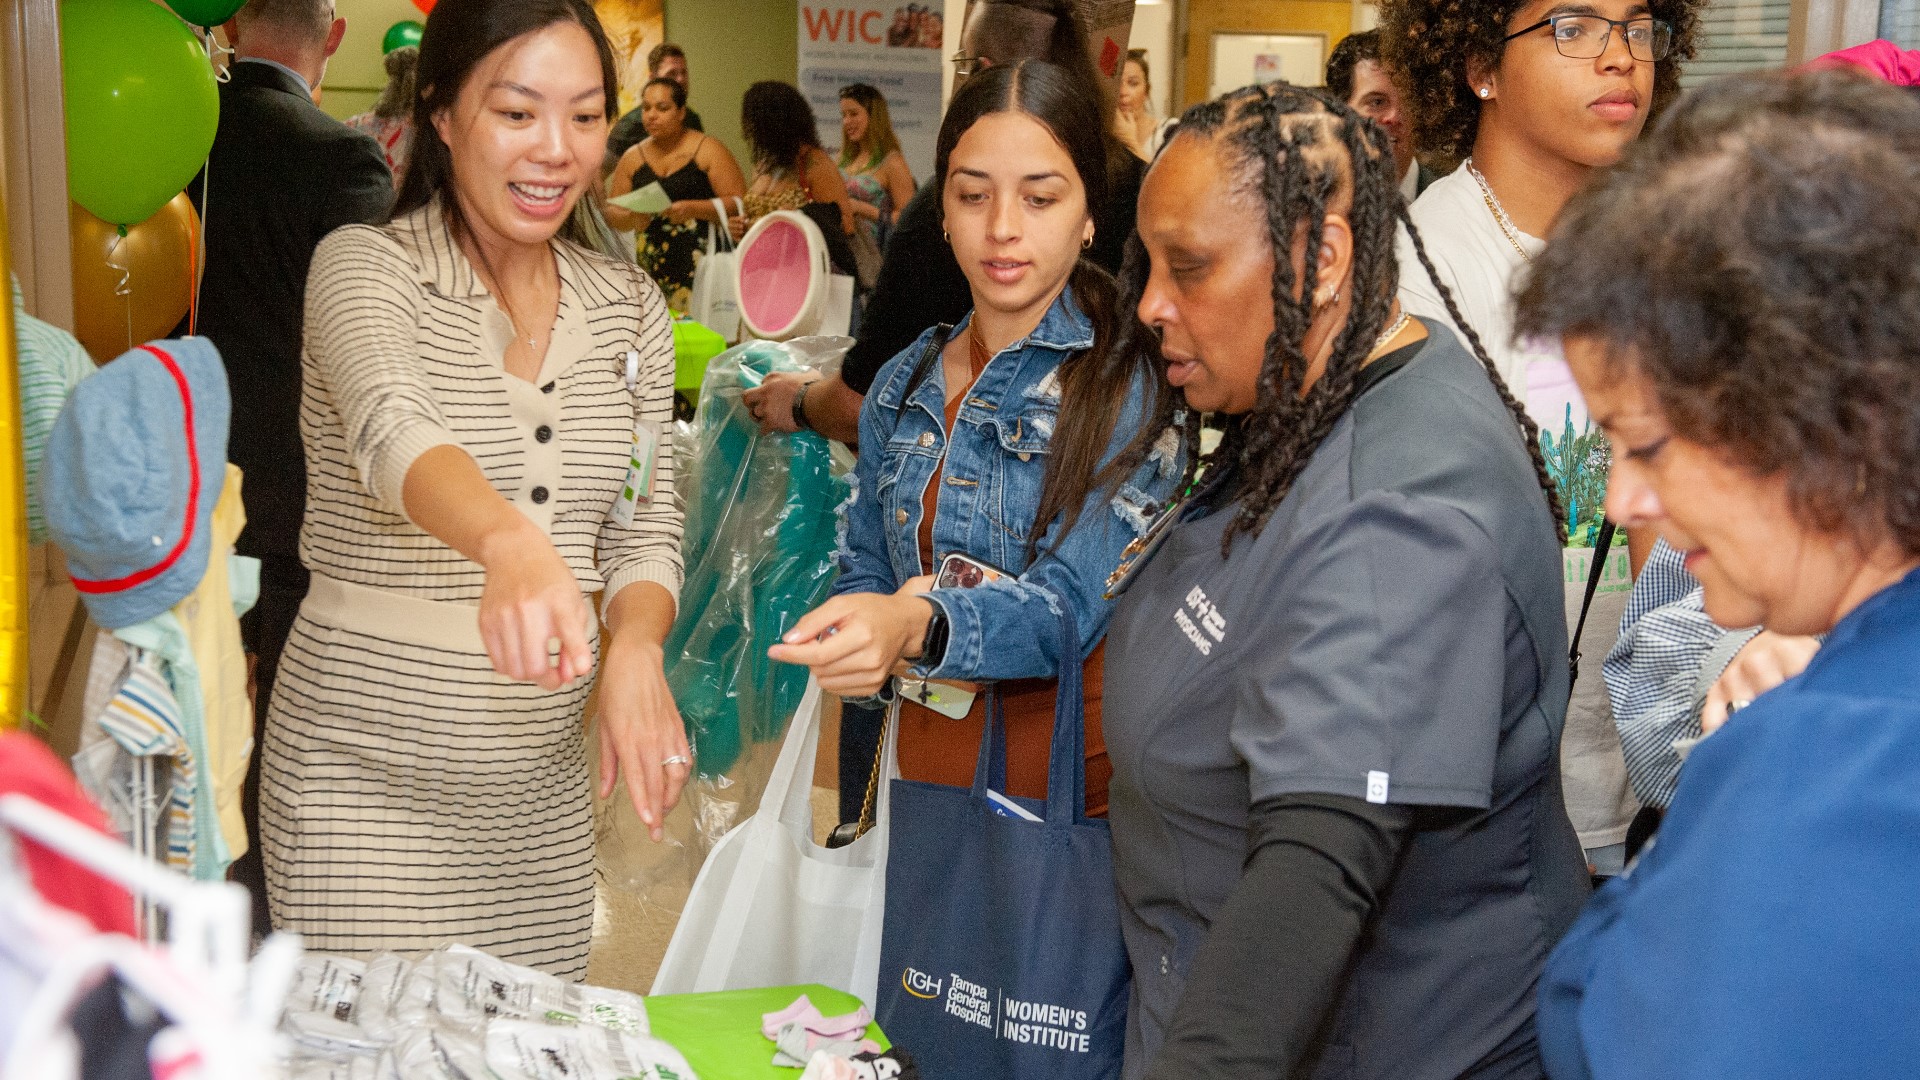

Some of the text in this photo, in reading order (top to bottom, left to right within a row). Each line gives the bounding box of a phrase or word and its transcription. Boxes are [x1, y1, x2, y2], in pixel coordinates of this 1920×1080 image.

[802, 6, 883, 44] WIC
[907, 967, 943, 996] TGH
[950, 973, 988, 1000] Tampa
[948, 987, 991, 1014] General
[1005, 998, 1088, 1031] WOMEN'S
[1003, 1019, 1091, 1054] INSTITUTE
